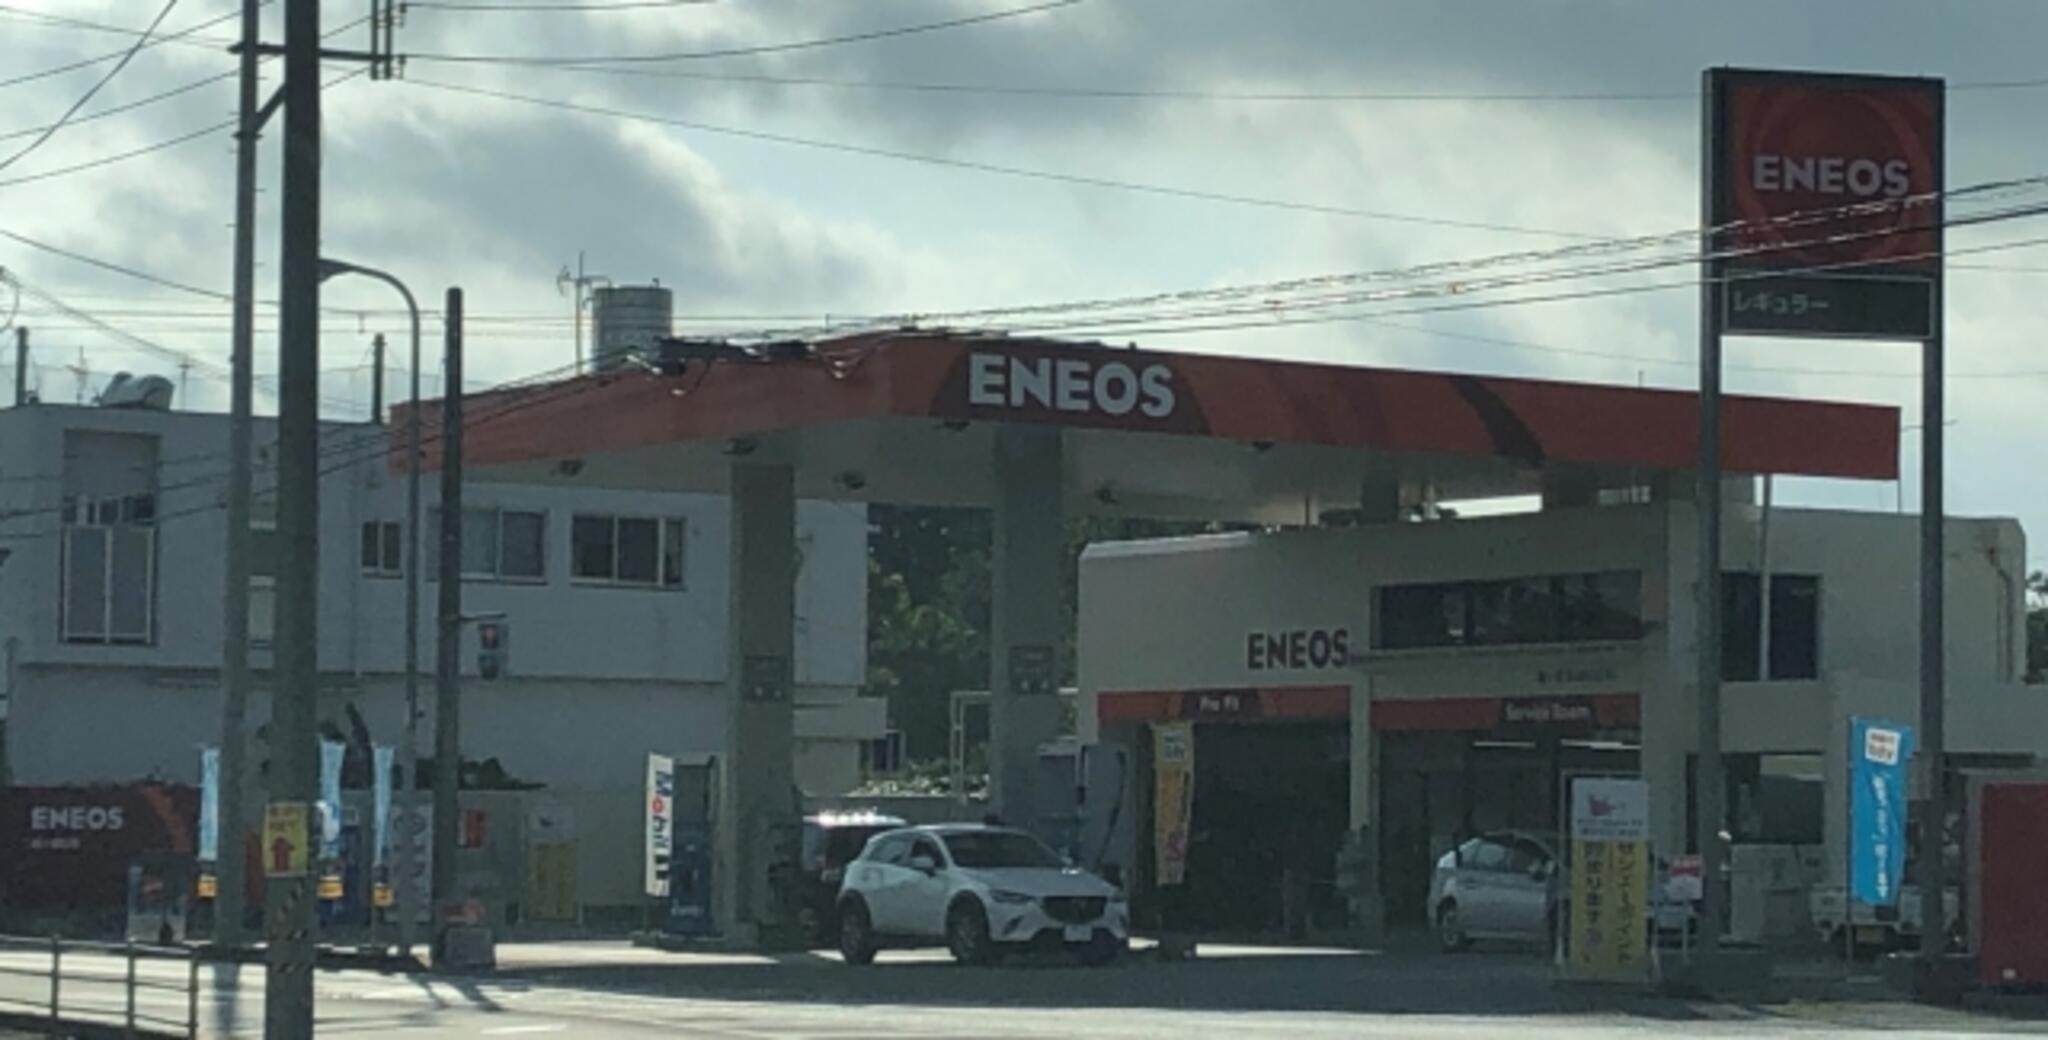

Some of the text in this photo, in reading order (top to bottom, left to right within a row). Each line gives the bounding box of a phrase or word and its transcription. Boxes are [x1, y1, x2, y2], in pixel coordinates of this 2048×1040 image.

[1753, 155, 1910, 195] ENEOS
[1733, 289, 1831, 315] レギュラー
[968, 352, 1176, 418] ENEOS
[1247, 628, 1349, 669] ENEOS
[31, 806, 124, 830] ENEOS
